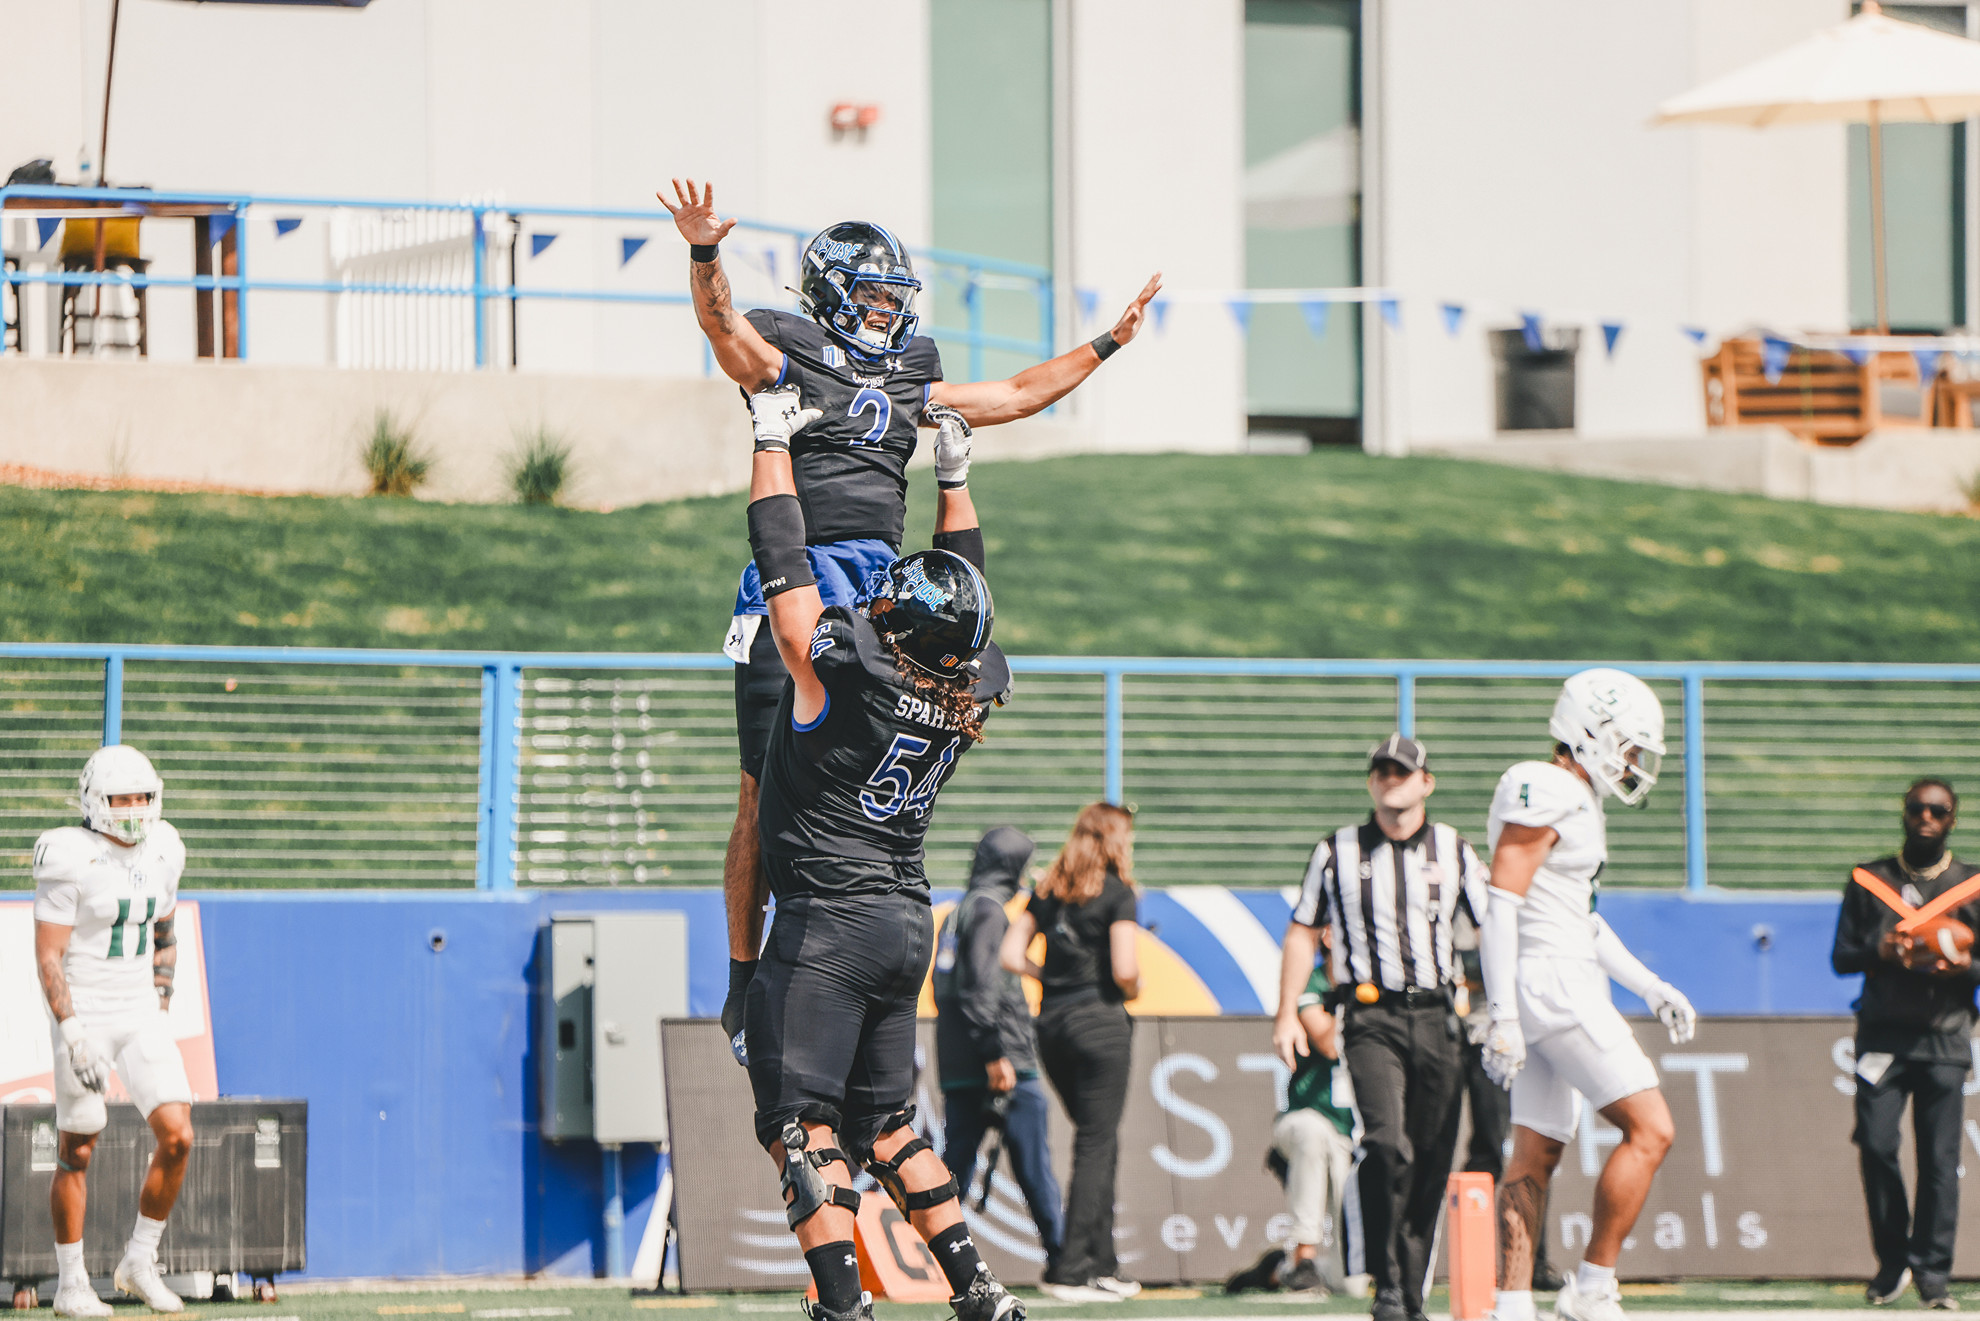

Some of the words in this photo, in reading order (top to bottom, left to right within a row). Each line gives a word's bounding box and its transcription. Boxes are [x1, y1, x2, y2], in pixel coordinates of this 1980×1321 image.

[848, 388, 892, 451] 2
[902, 557, 925, 582] SAN
[902, 578, 952, 612] JOSE
[859, 732, 961, 822] 54
[107, 896, 157, 958] 11
